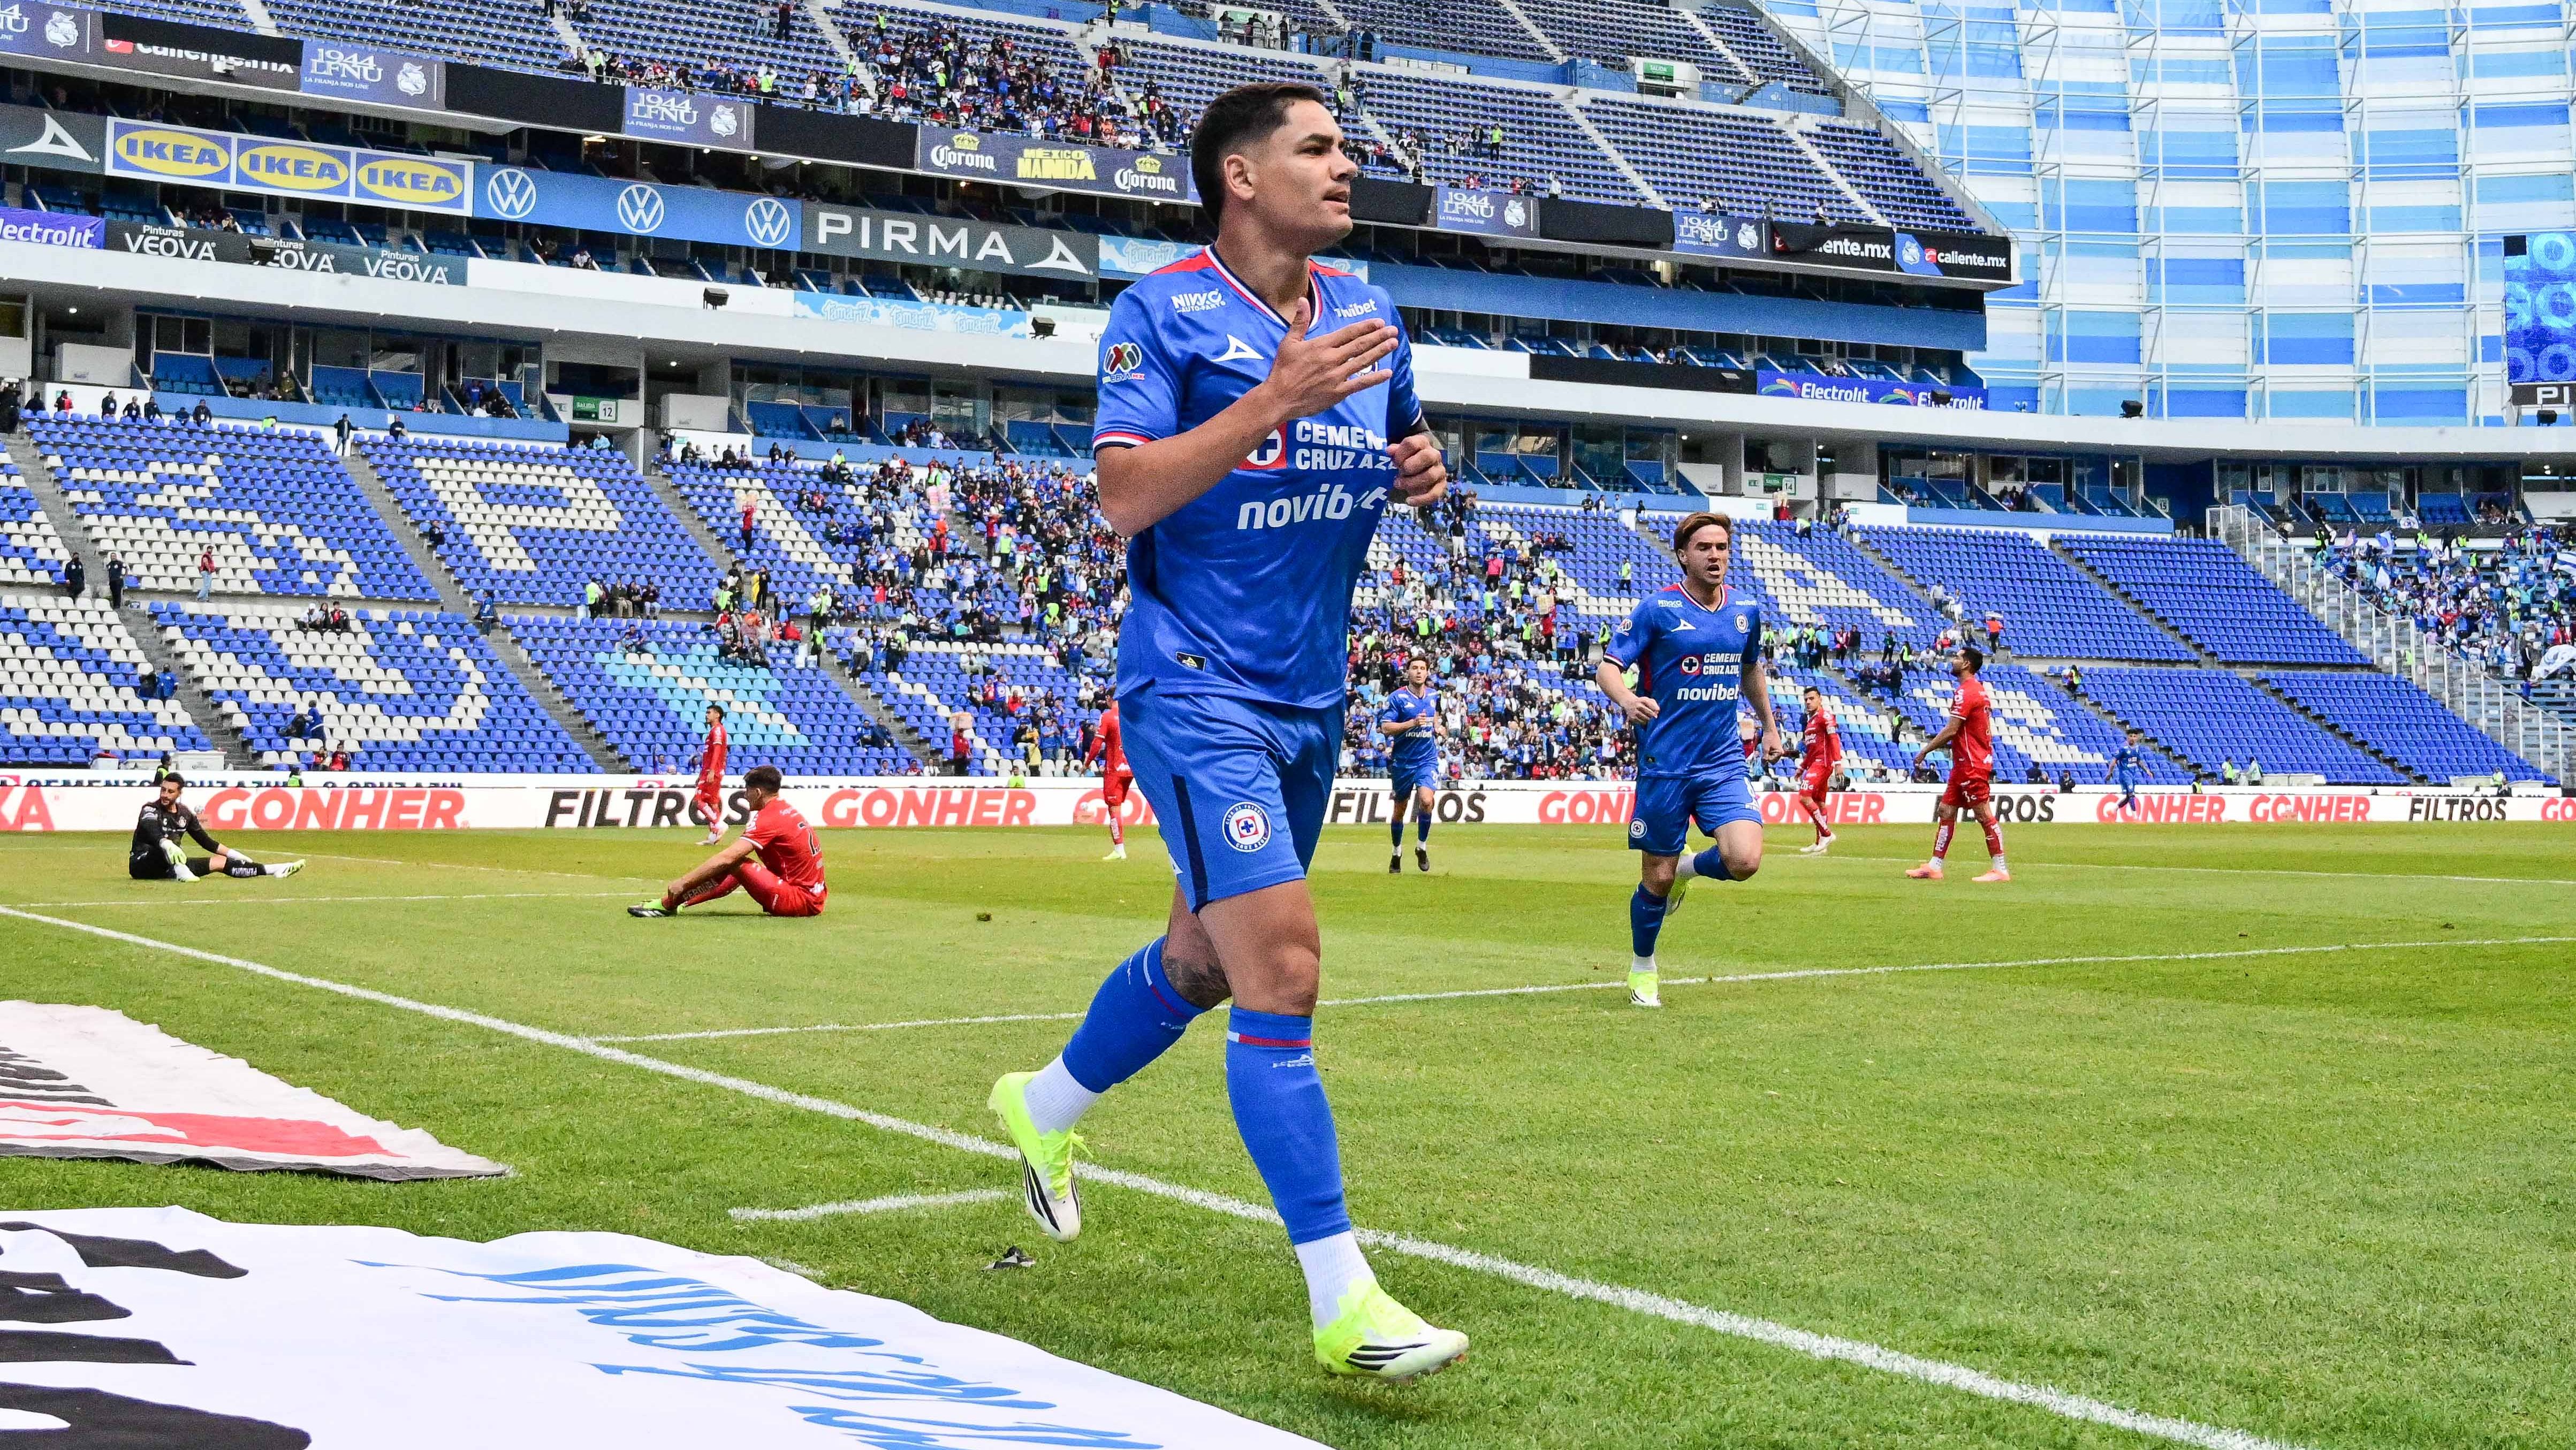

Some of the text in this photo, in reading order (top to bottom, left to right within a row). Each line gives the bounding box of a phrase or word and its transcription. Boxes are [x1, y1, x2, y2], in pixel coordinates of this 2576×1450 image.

[310, 58, 384, 82] LFNU
[317, 48, 376, 69] 1944
[632, 103, 698, 124] LFNU
[639, 93, 693, 113] 1944
[126, 138, 221, 167] IKEA
[931, 145, 995, 170] Corona
[249, 154, 341, 182] IKEA
[367, 167, 457, 194] IKEA
[1114, 169, 1176, 193] Corona
[1443, 200, 1494, 218] LFNU
[1447, 192, 1490, 208] 1944
[0, 218, 95, 248] lectrolit
[143, 224, 185, 238] Pinturas
[1682, 216, 1723, 231] 1944
[125, 233, 216, 261] VEOVA
[818, 212, 1014, 264] PIRMA
[381, 249, 420, 262] Pinturas
[1937, 250, 2007, 268] caliente.mx
[364, 257, 449, 285] VEOVA
[1801, 382, 1868, 403] Electrolit
[603, 407, 613, 417] 12
[1295, 448, 1397, 470] CRUZ AZ
[1237, 483, 1388, 530] novibt
[1703, 665, 1724, 675] CRUZ
[204, 788, 465, 829] GONHER
[545, 790, 750, 827] FILTROS
[822, 788, 1036, 826] GONHER
[2096, 793, 2225, 822] GONHER
[2250, 793, 2370, 822] GONHER
[2408, 798, 2507, 821] FILTROS
